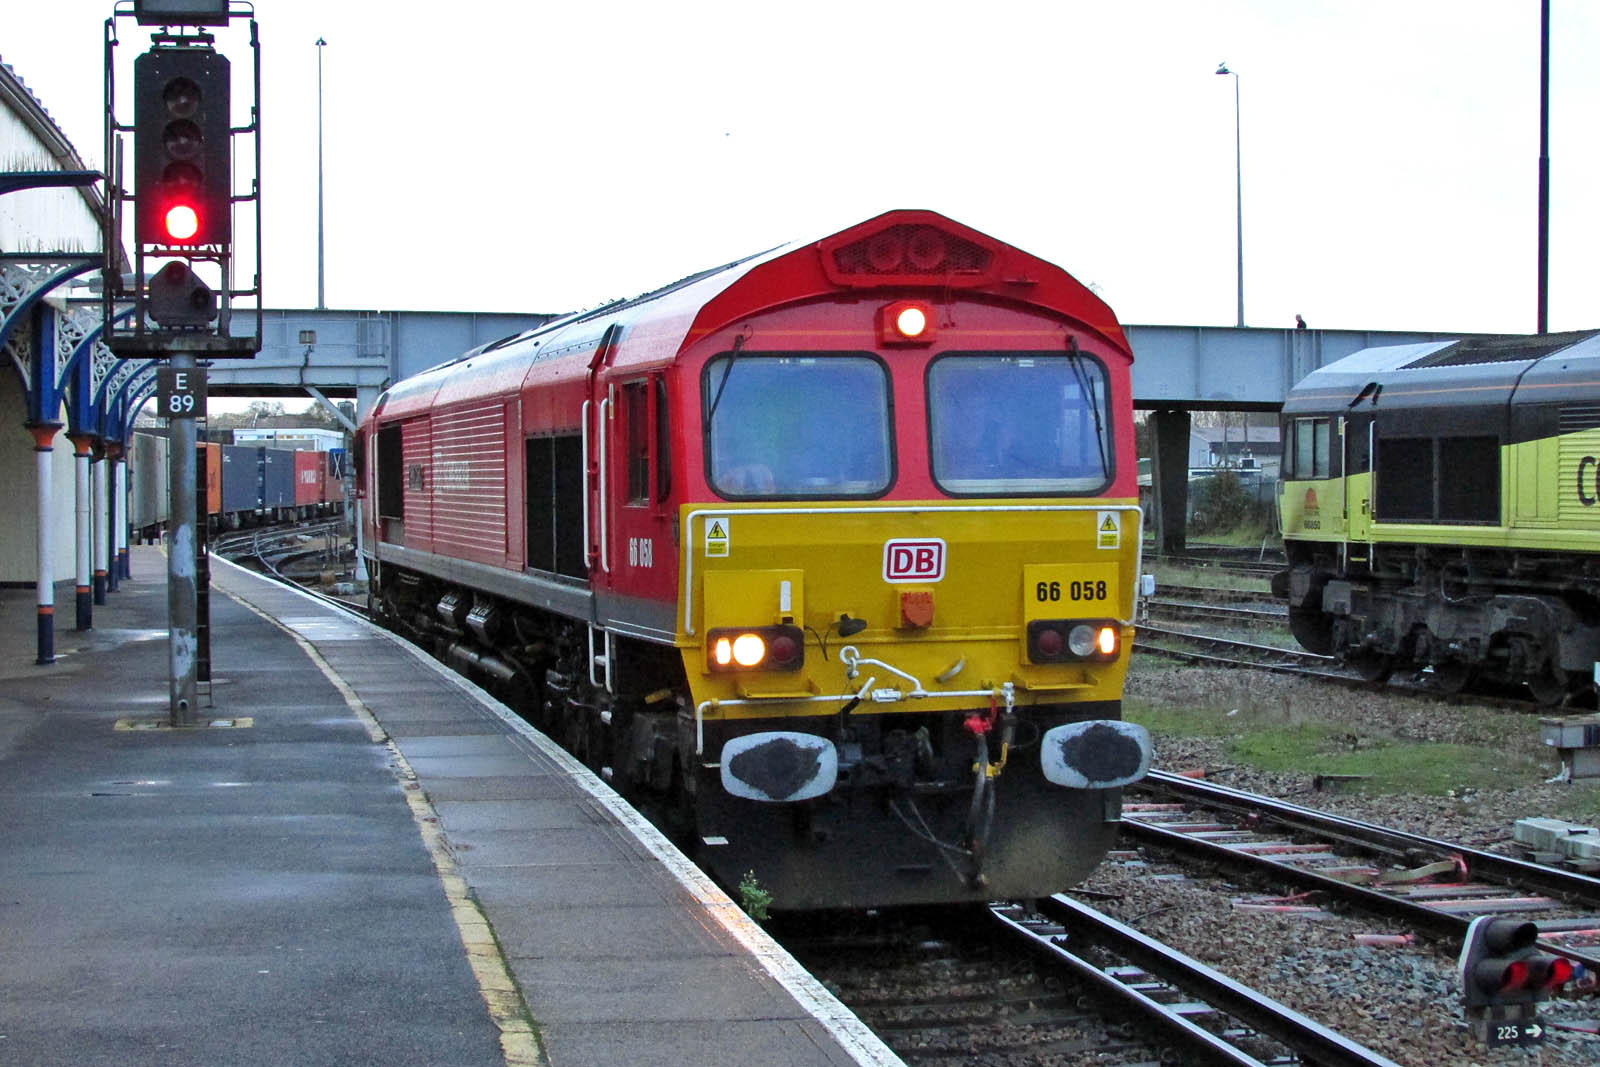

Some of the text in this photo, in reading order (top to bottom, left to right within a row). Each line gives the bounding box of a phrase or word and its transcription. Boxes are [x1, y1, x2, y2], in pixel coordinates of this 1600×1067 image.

[176, 373, 188, 390] E
[170, 395, 194, 412] 89
[1577, 456, 1600, 506] C
[629, 537, 638, 567] 66
[893, 548, 935, 573] DB
[1036, 580, 1107, 602] 66 058
[1497, 1025, 1519, 1040] 225
